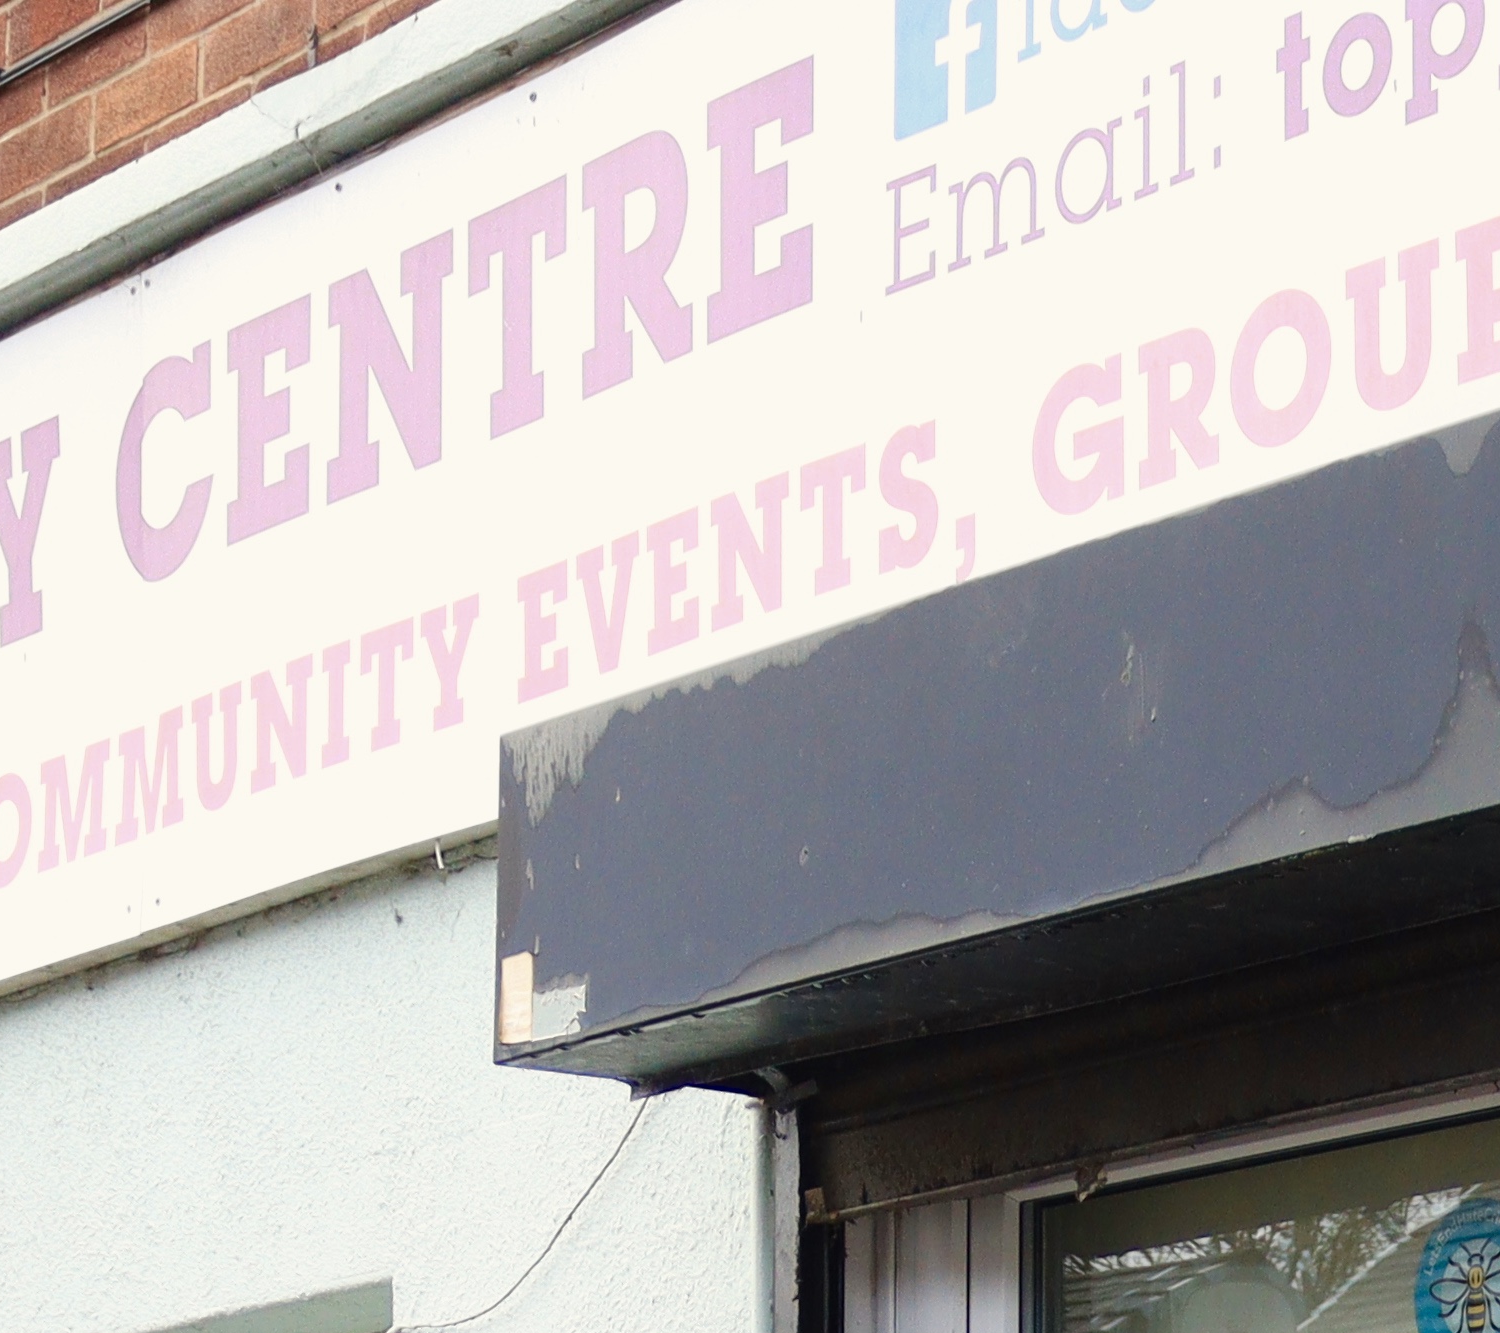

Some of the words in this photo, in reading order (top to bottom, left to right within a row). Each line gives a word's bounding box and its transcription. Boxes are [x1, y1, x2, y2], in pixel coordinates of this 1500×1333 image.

[115, 54, 815, 583] CENTRE
[885, 66, 1222, 297] Email:
[517, 420, 978, 704] EVENTS,
